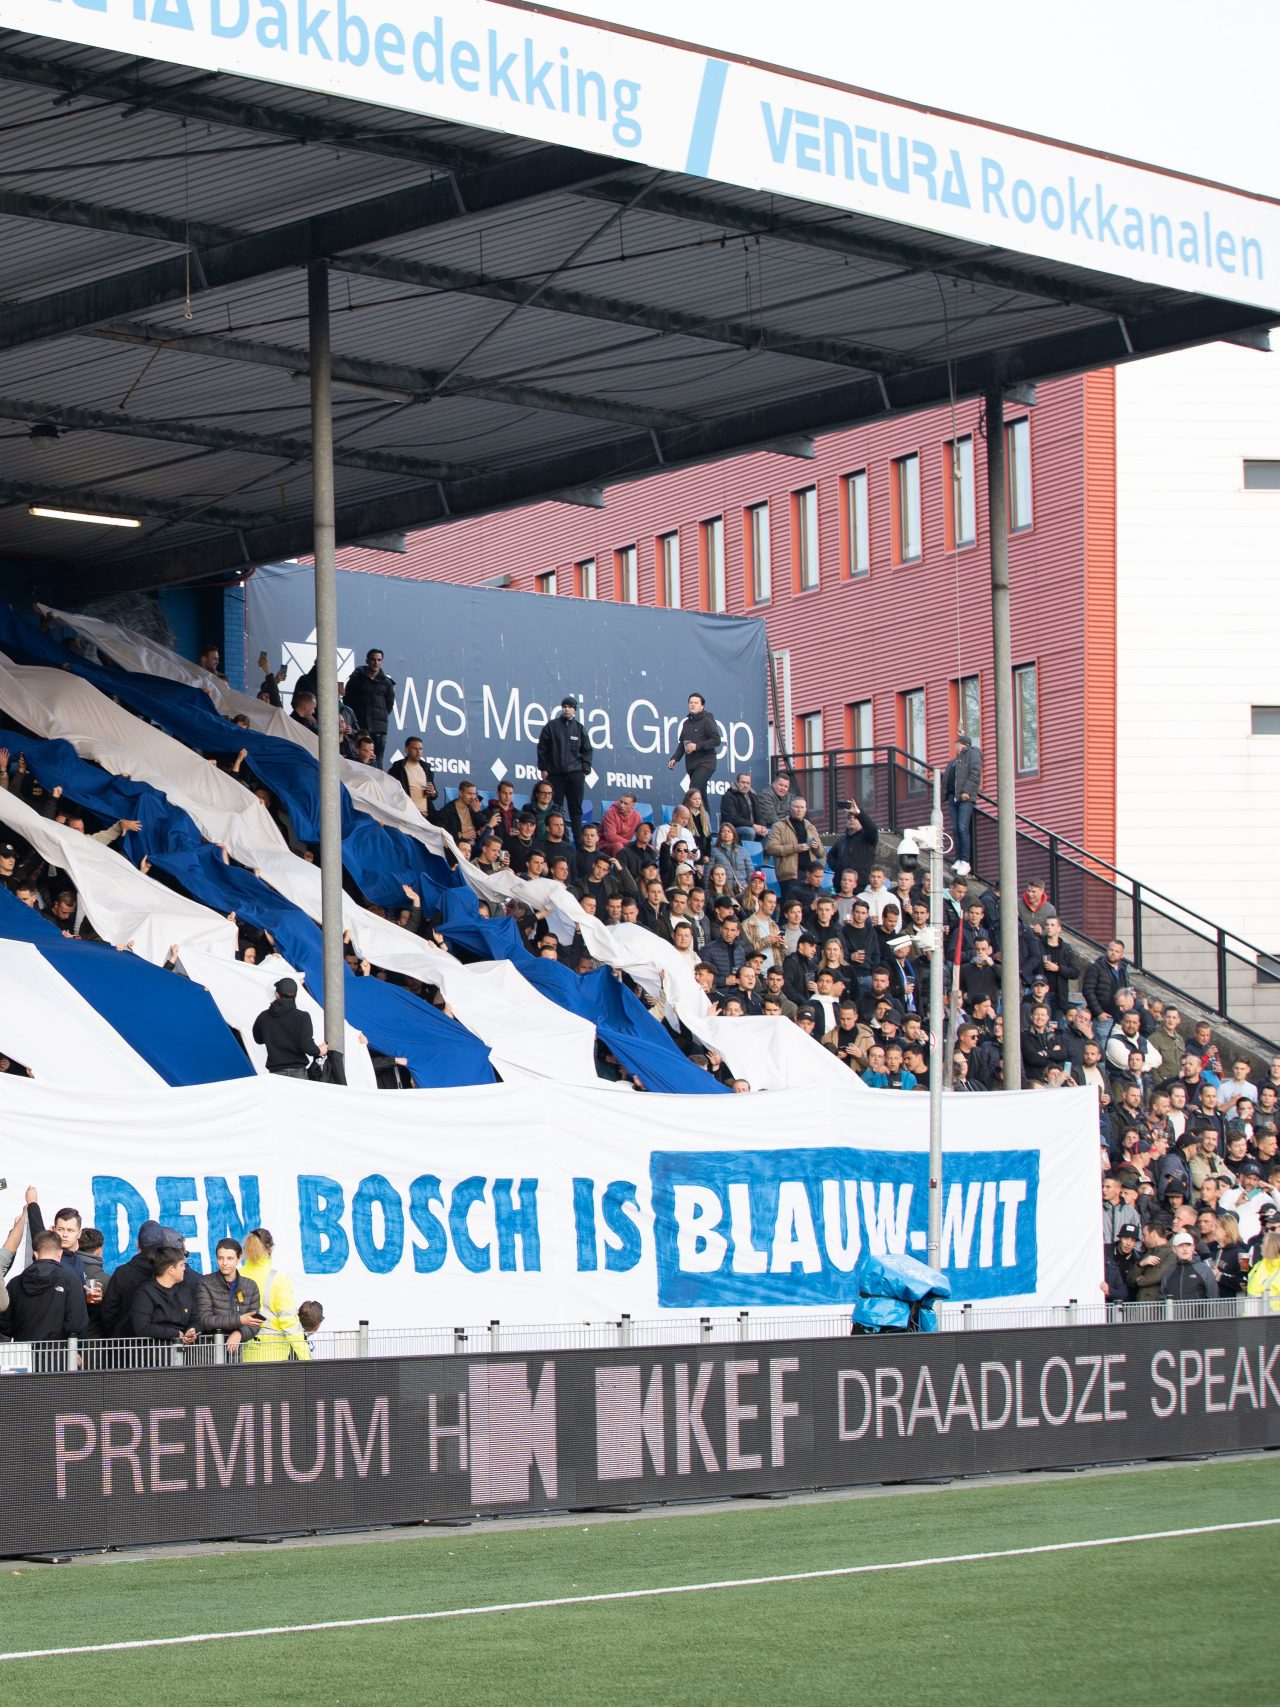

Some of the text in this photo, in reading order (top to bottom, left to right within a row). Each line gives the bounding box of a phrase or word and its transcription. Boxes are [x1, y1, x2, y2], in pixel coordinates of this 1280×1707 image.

[211, 0, 642, 149] Dakbedekking
[761, 100, 1265, 281] VENTURA Rookkanalen
[483, 684, 614, 750] Meia
[626, 699, 755, 773] Grep
[606, 772, 654, 790] PRINT
[92, 1174, 261, 1273] DEN
[297, 1173, 541, 1275] BOSCH
[572, 1176, 644, 1273] IS
[837, 1345, 1280, 1442] DRAADLOZE SPEAK
[55, 1396, 391, 1500] PREMIUM
